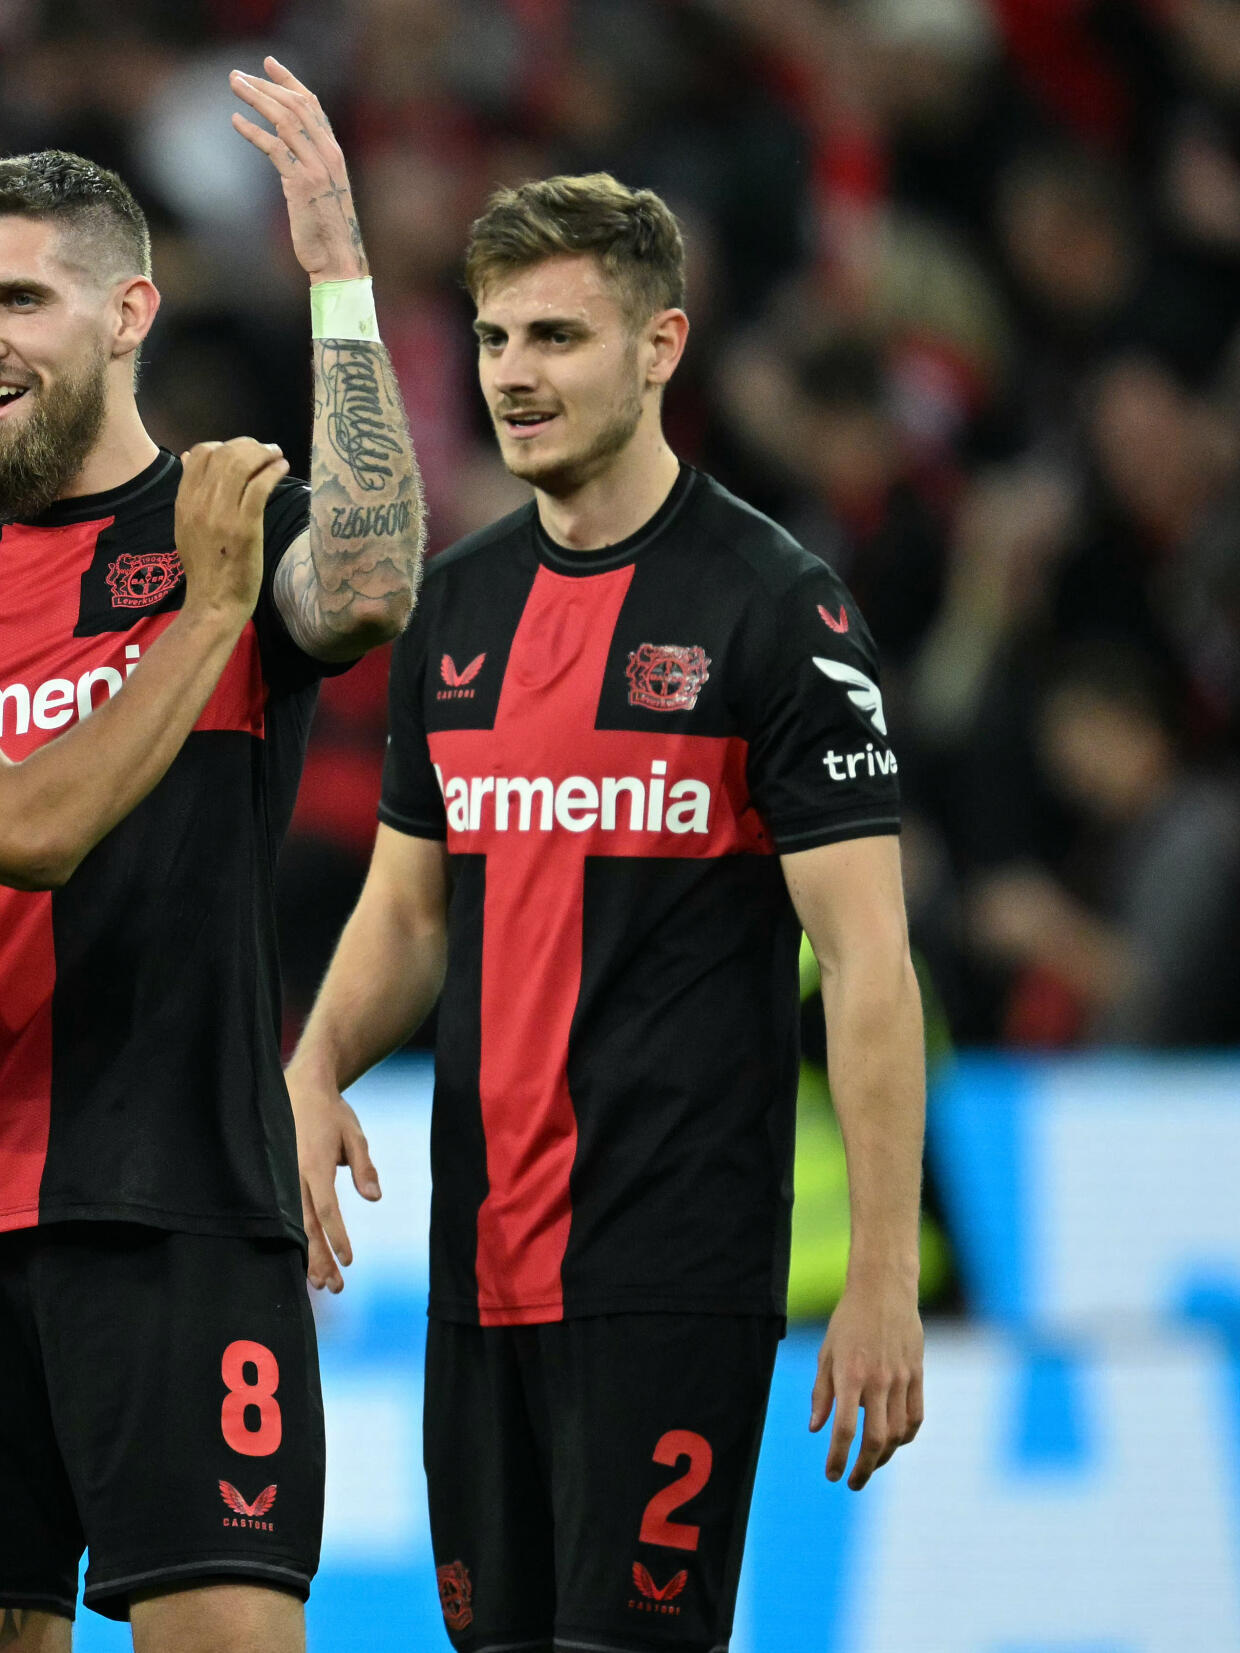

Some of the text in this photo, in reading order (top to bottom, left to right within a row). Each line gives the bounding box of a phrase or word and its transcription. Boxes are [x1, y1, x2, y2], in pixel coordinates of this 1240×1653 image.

[220, 1340, 282, 1457] 8
[223, 1518, 274, 1532] CASTORE
[638, 1429, 714, 1552] 2
